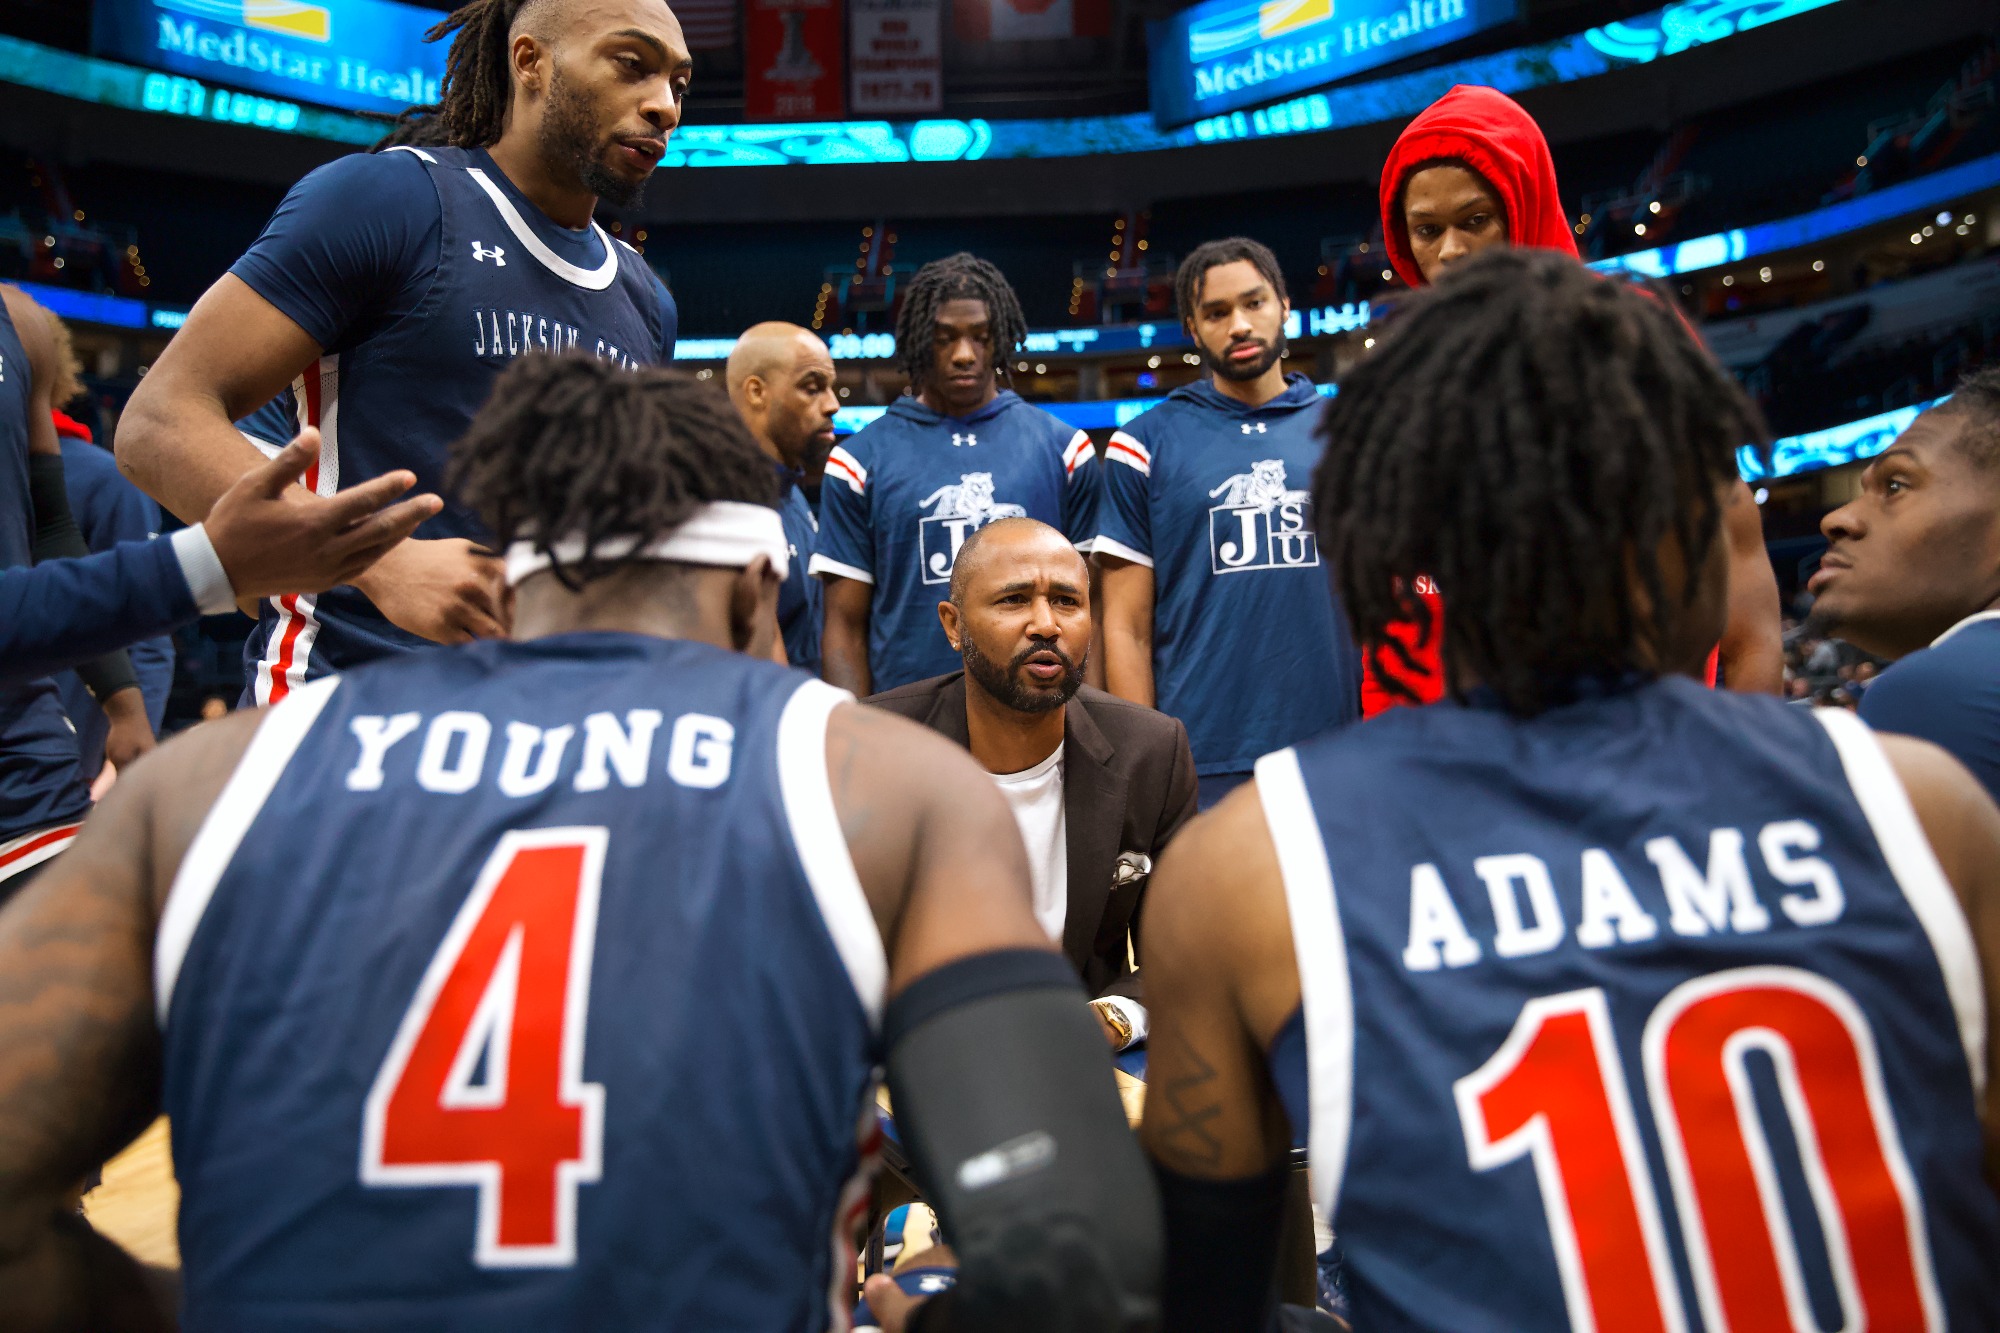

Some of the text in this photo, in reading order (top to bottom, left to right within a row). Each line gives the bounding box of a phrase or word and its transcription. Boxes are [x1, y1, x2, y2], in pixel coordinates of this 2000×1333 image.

[157, 12, 447, 105] MedStar Healt
[1194, 36, 1333, 100] MedStar
[345, 708, 736, 798] YOUNG
[1402, 819, 1845, 972] ADAMS
[360, 826, 609, 1269] 4
[1452, 965, 1948, 1333] 10
